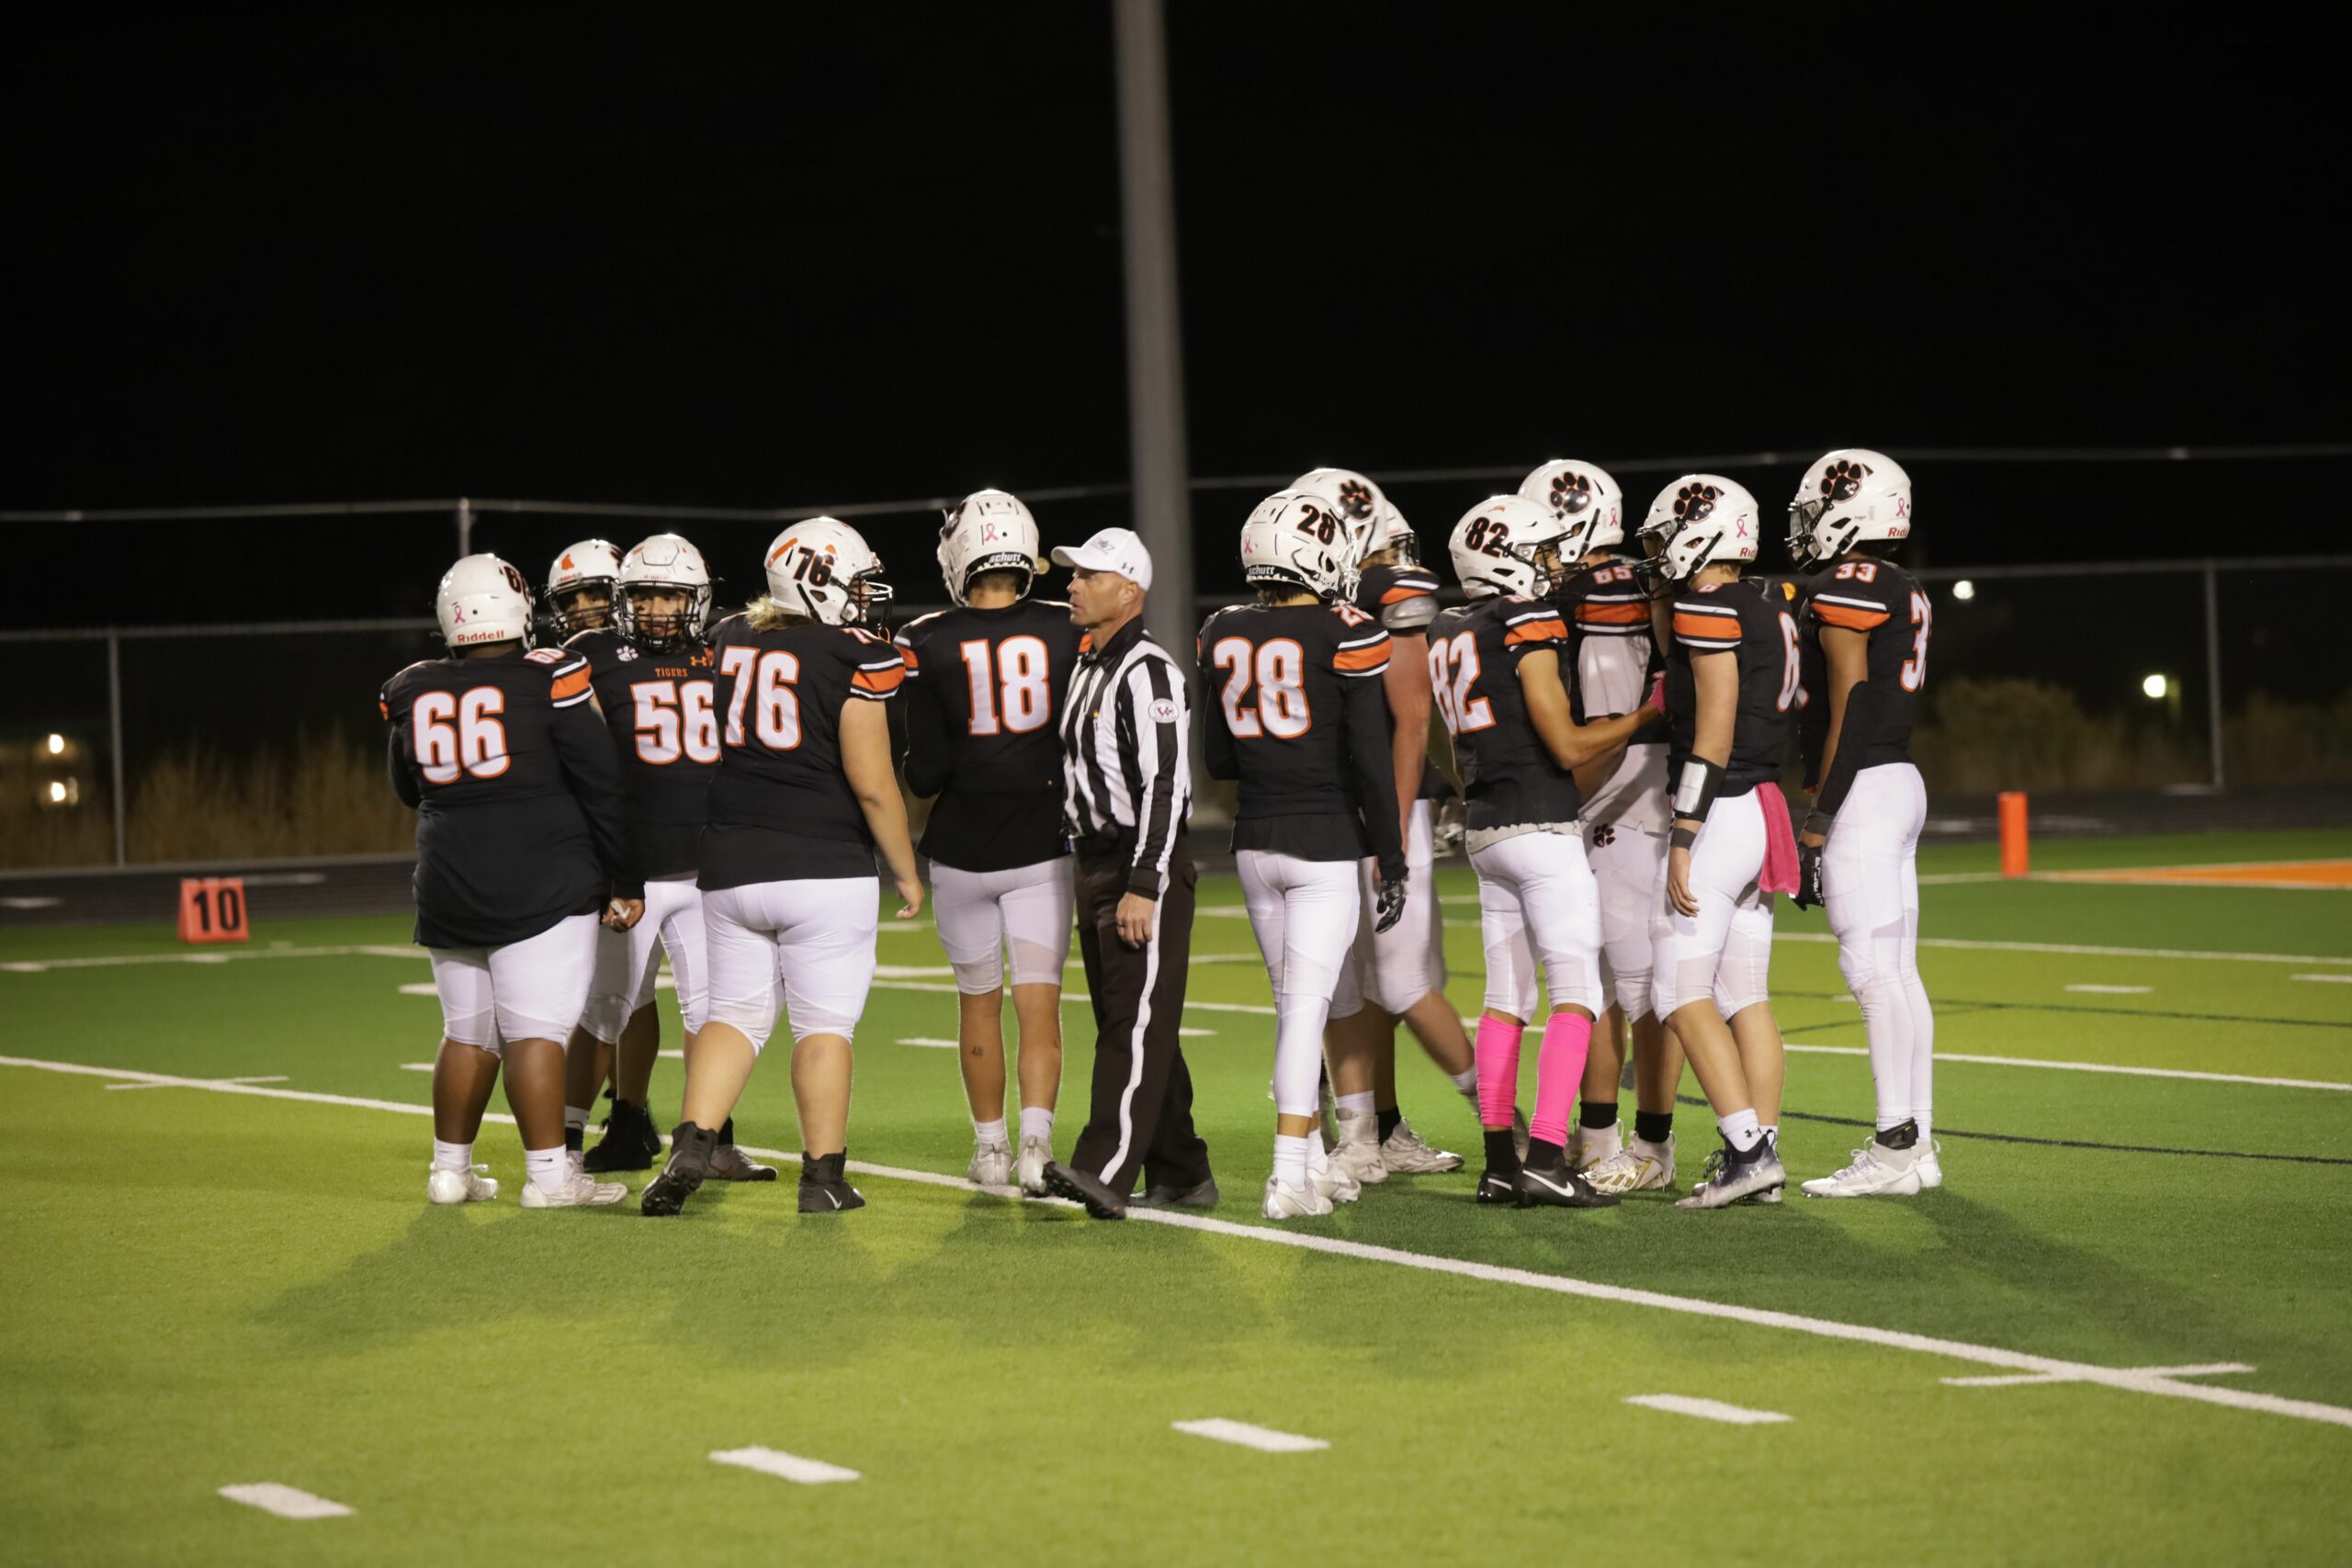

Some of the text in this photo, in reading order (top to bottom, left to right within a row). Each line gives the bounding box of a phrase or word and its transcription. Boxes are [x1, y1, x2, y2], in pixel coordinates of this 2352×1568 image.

[1296, 504, 1337, 546] 28
[1465, 516, 1510, 558] 82
[793, 546, 835, 587] 76
[989, 552, 1022, 564] schutt
[1836, 563, 1877, 582] 33
[457, 630, 504, 644] Riddell
[655, 668, 688, 678] TIGERS
[960, 634, 1051, 736] 18
[1213, 636, 1312, 739] 28
[1428, 629, 1497, 736] 82
[719, 645, 802, 750] 76
[413, 685, 510, 784] 66
[630, 680, 721, 765] 56
[192, 888, 241, 933] 10
